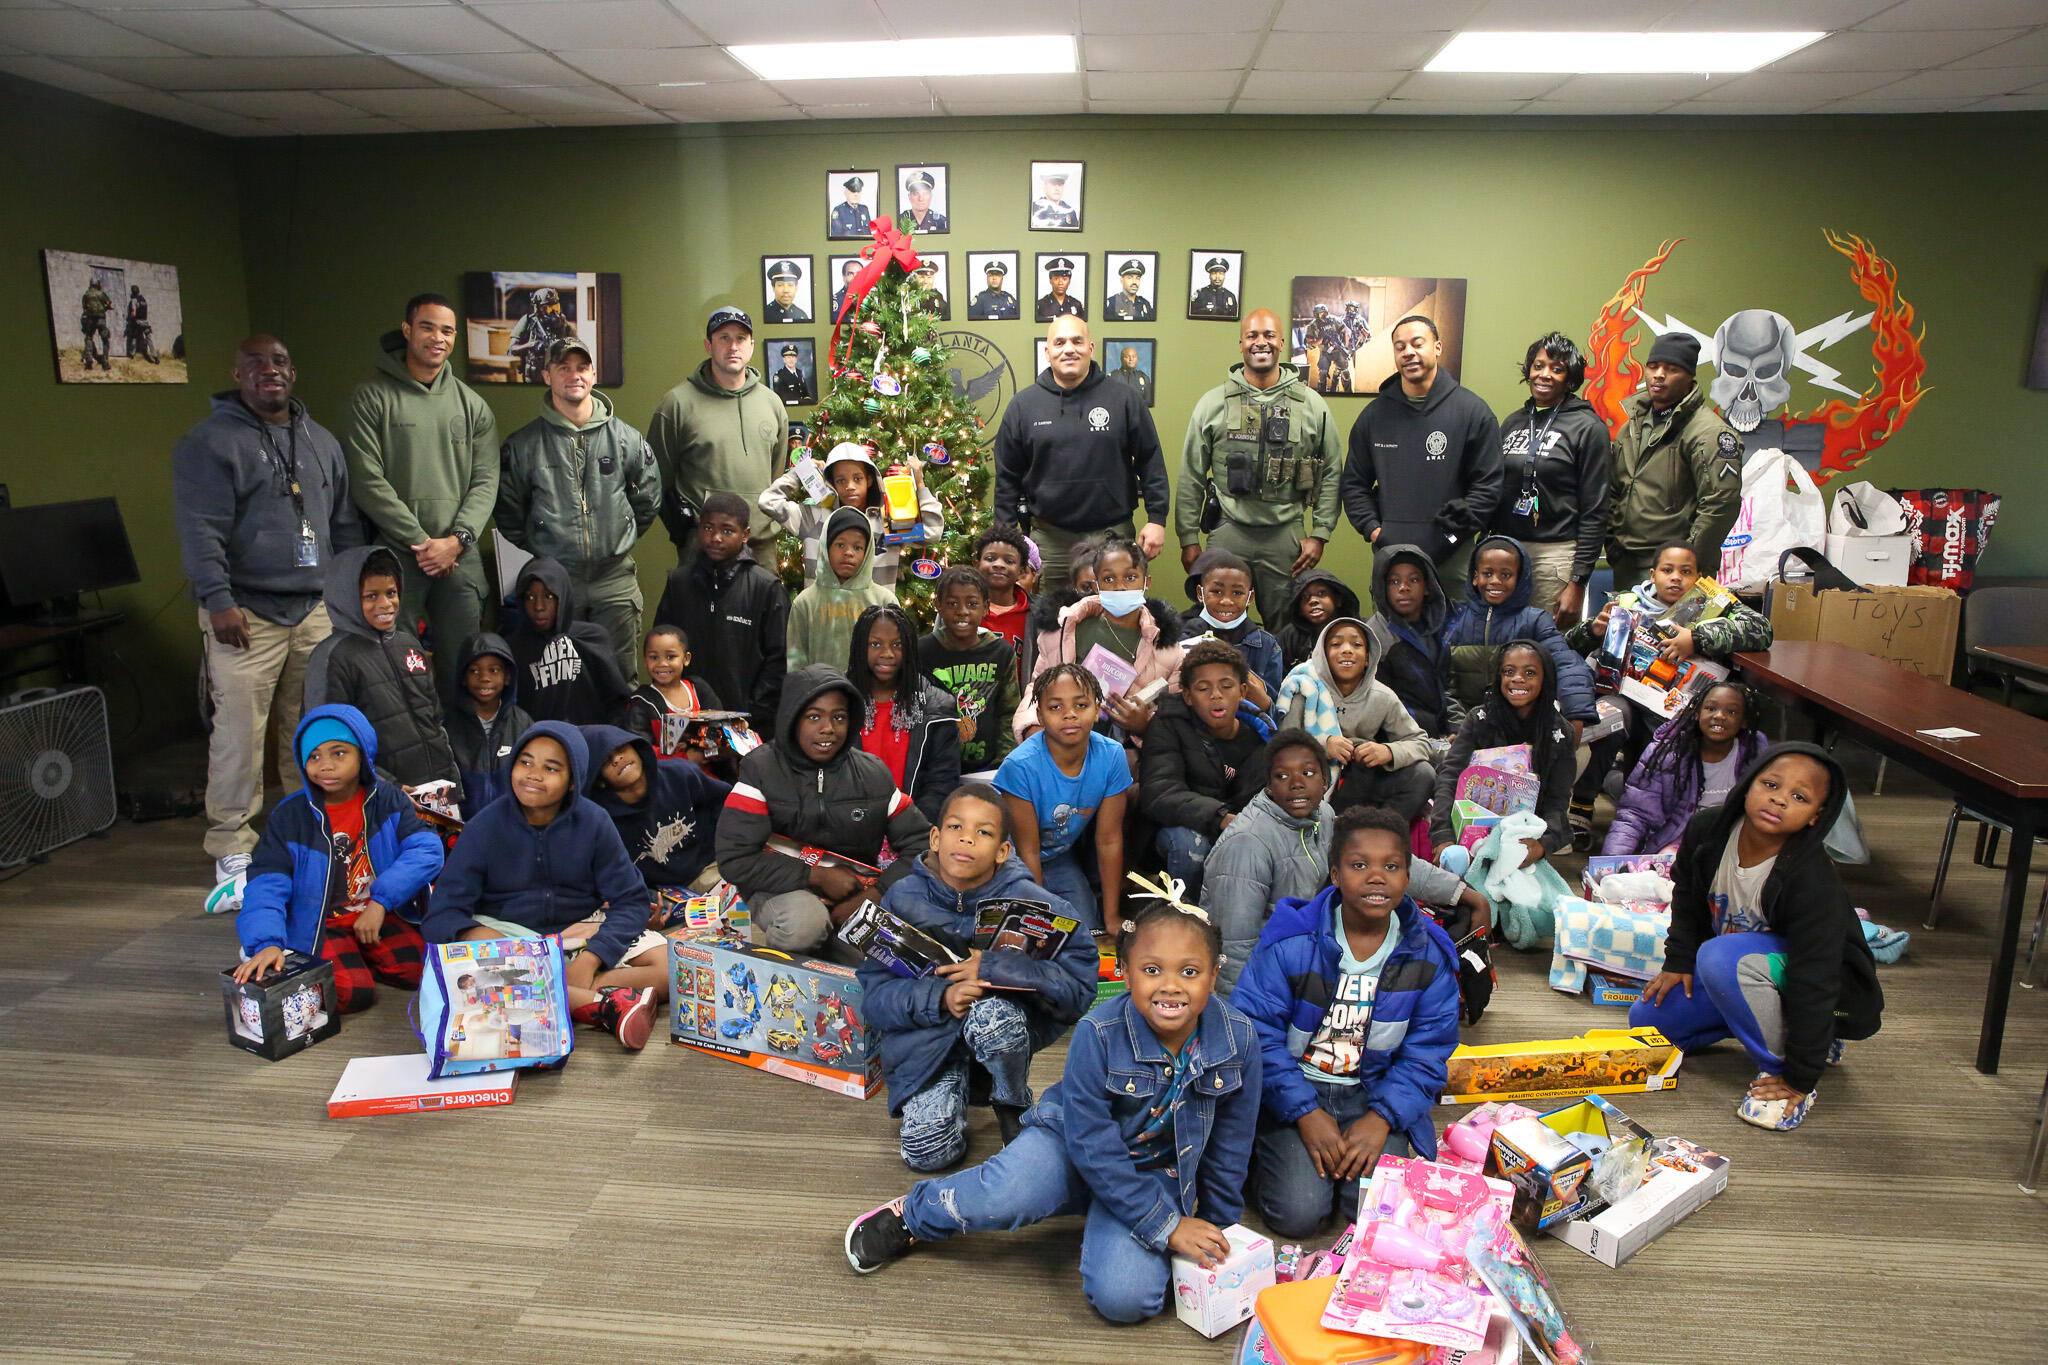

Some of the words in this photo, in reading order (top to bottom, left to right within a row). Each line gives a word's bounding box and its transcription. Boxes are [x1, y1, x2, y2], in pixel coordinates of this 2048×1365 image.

[1848, 598, 1927, 635] TOYS
[1602, 991, 1640, 1002] TROUBLE
[445, 1091, 510, 1106] Checkers
[1493, 1138, 1528, 1169] MONSTER
[1500, 1150, 1517, 1168] JAM
[1553, 1169, 1586, 1185] MONSTER
[1543, 1202, 1561, 1213] RC
